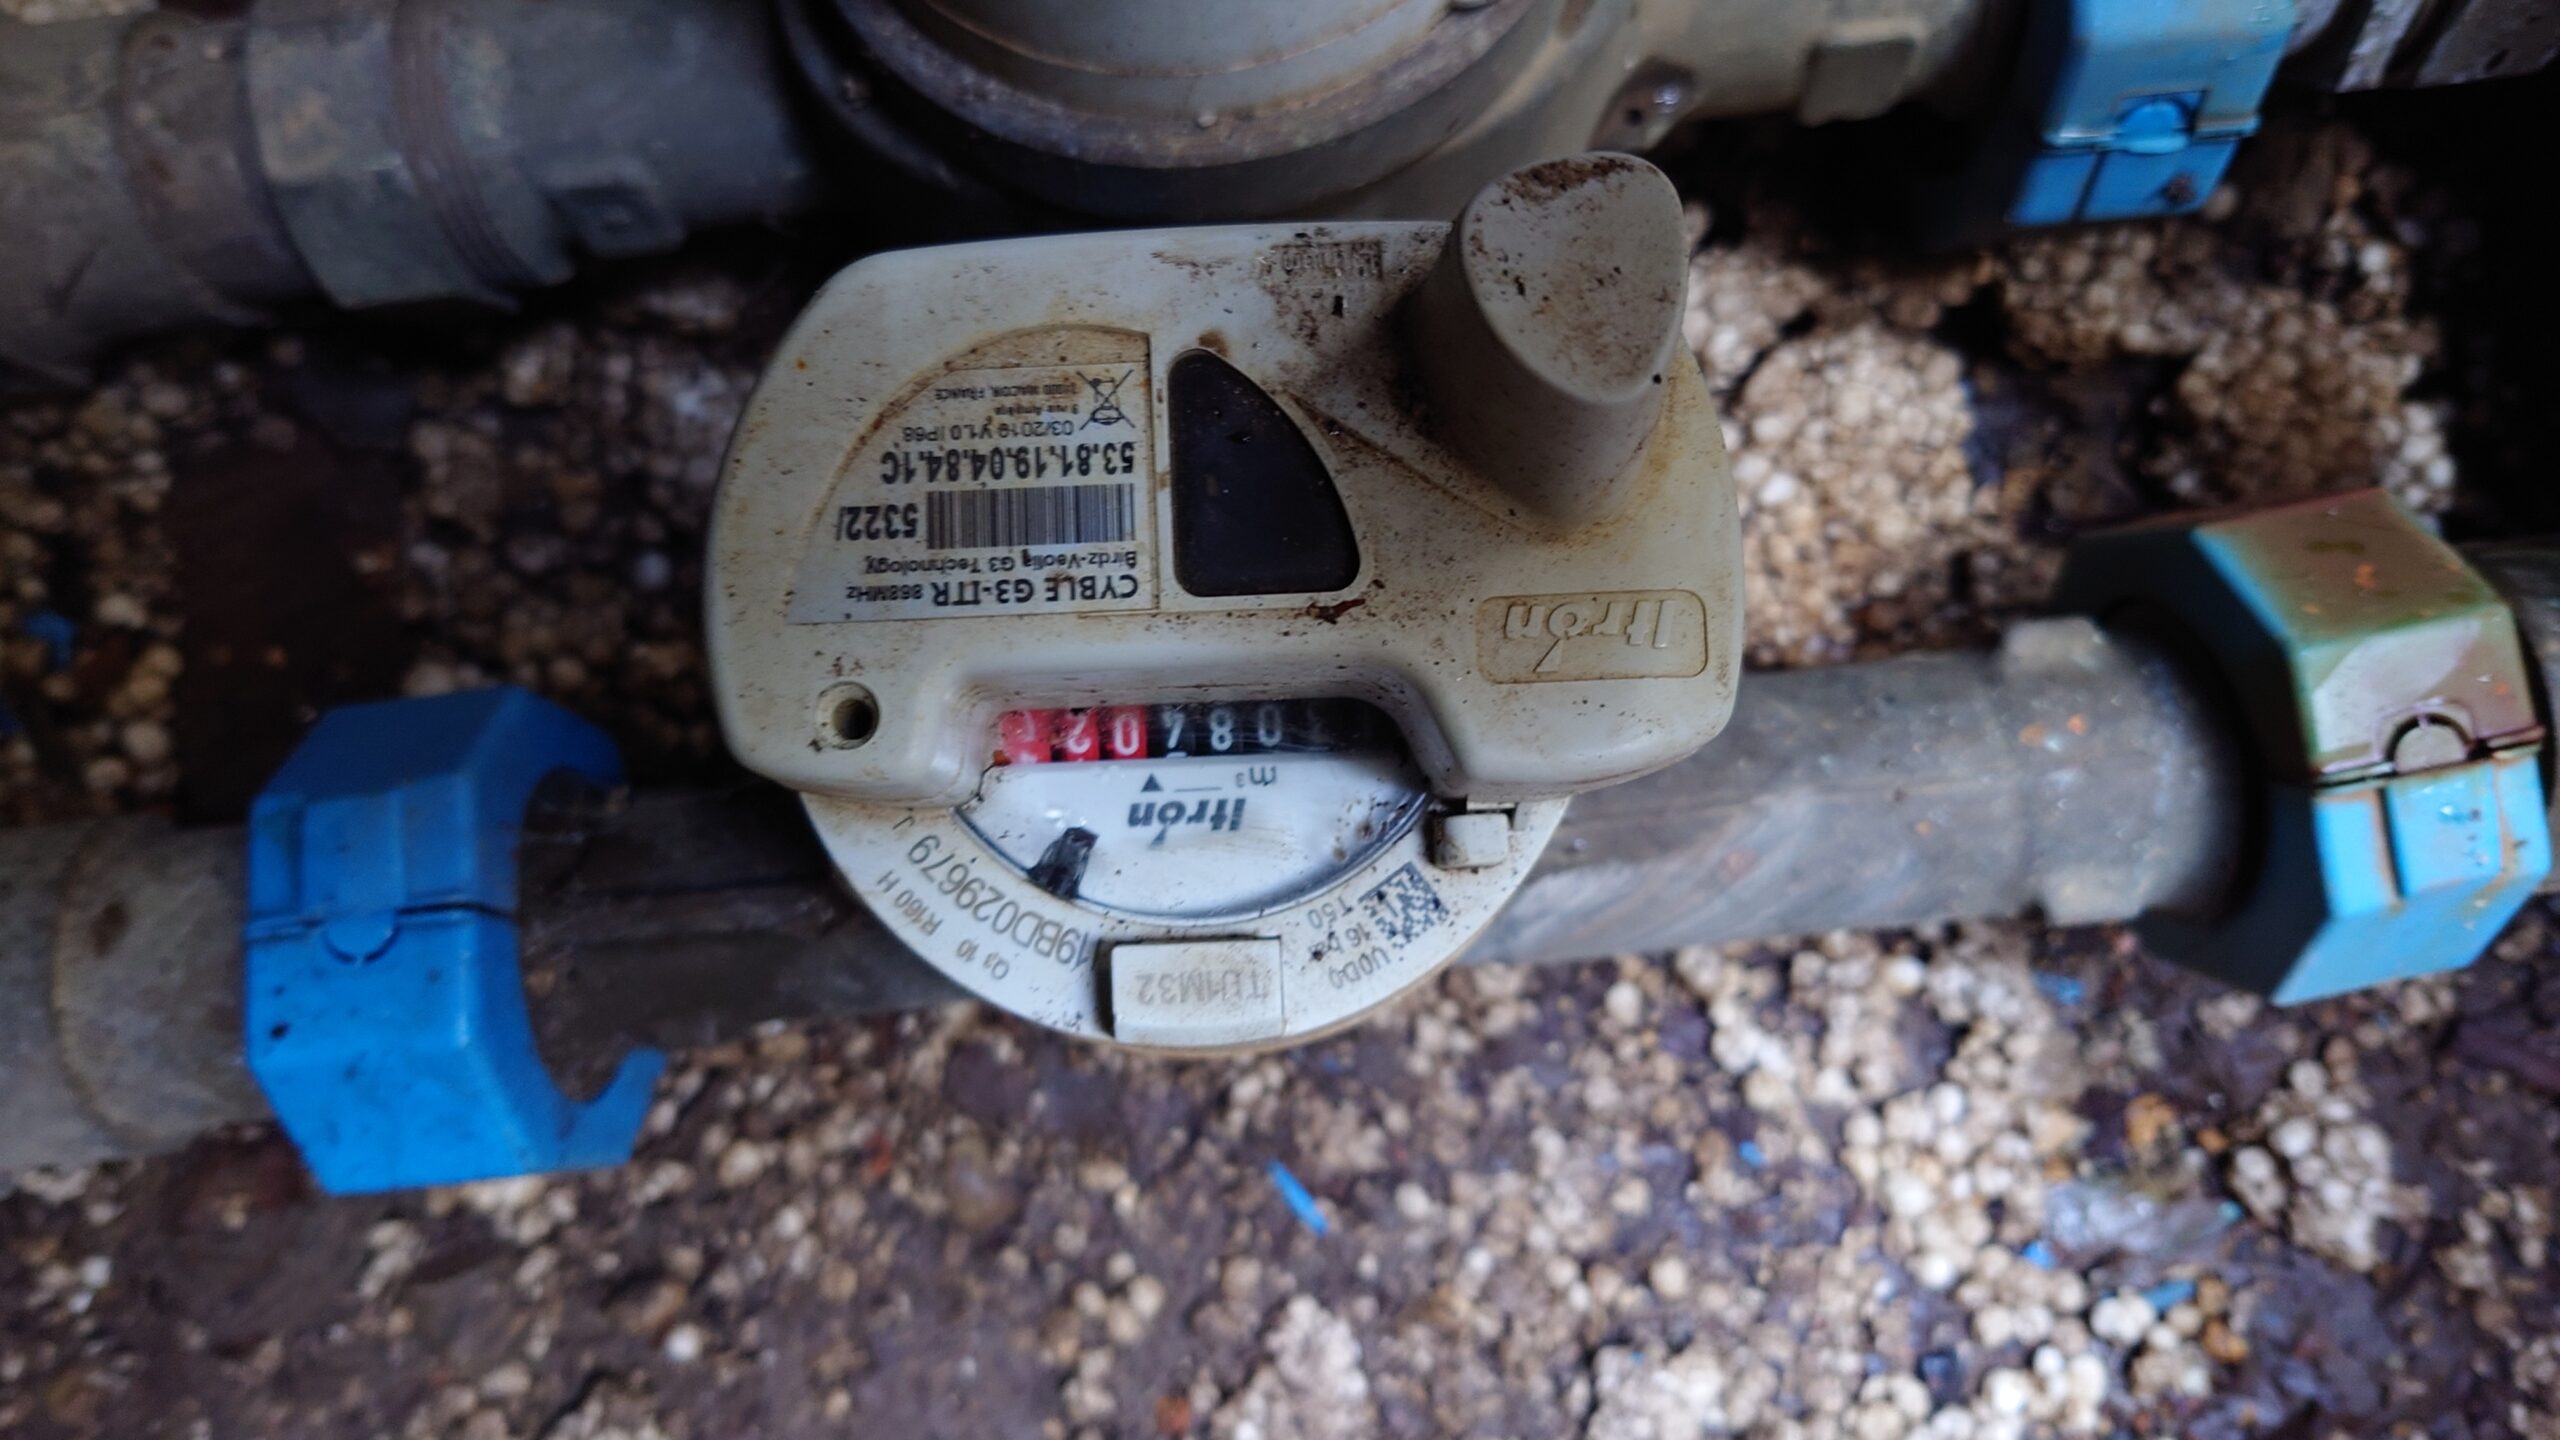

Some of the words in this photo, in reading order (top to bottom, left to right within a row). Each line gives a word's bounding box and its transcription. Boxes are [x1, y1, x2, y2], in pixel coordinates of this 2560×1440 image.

[903, 424, 945, 443] IP68
[880, 442, 1136, 485] 53.81.19.04.84.1C
[988, 558, 1016, 573] G3
[1024, 550, 1138, 572] Birdz-Veolia
[845, 582, 924, 602] 868MHz
[931, 577, 1035, 607] G3-ITR
[1044, 572, 1139, 602] CYBLE
[876, 869, 902, 894] H
[907, 834, 1092, 973] 19BD029679
[1307, 895, 1355, 930] T50
[1346, 921, 1373, 947] 16
[957, 937, 980, 963] 10
